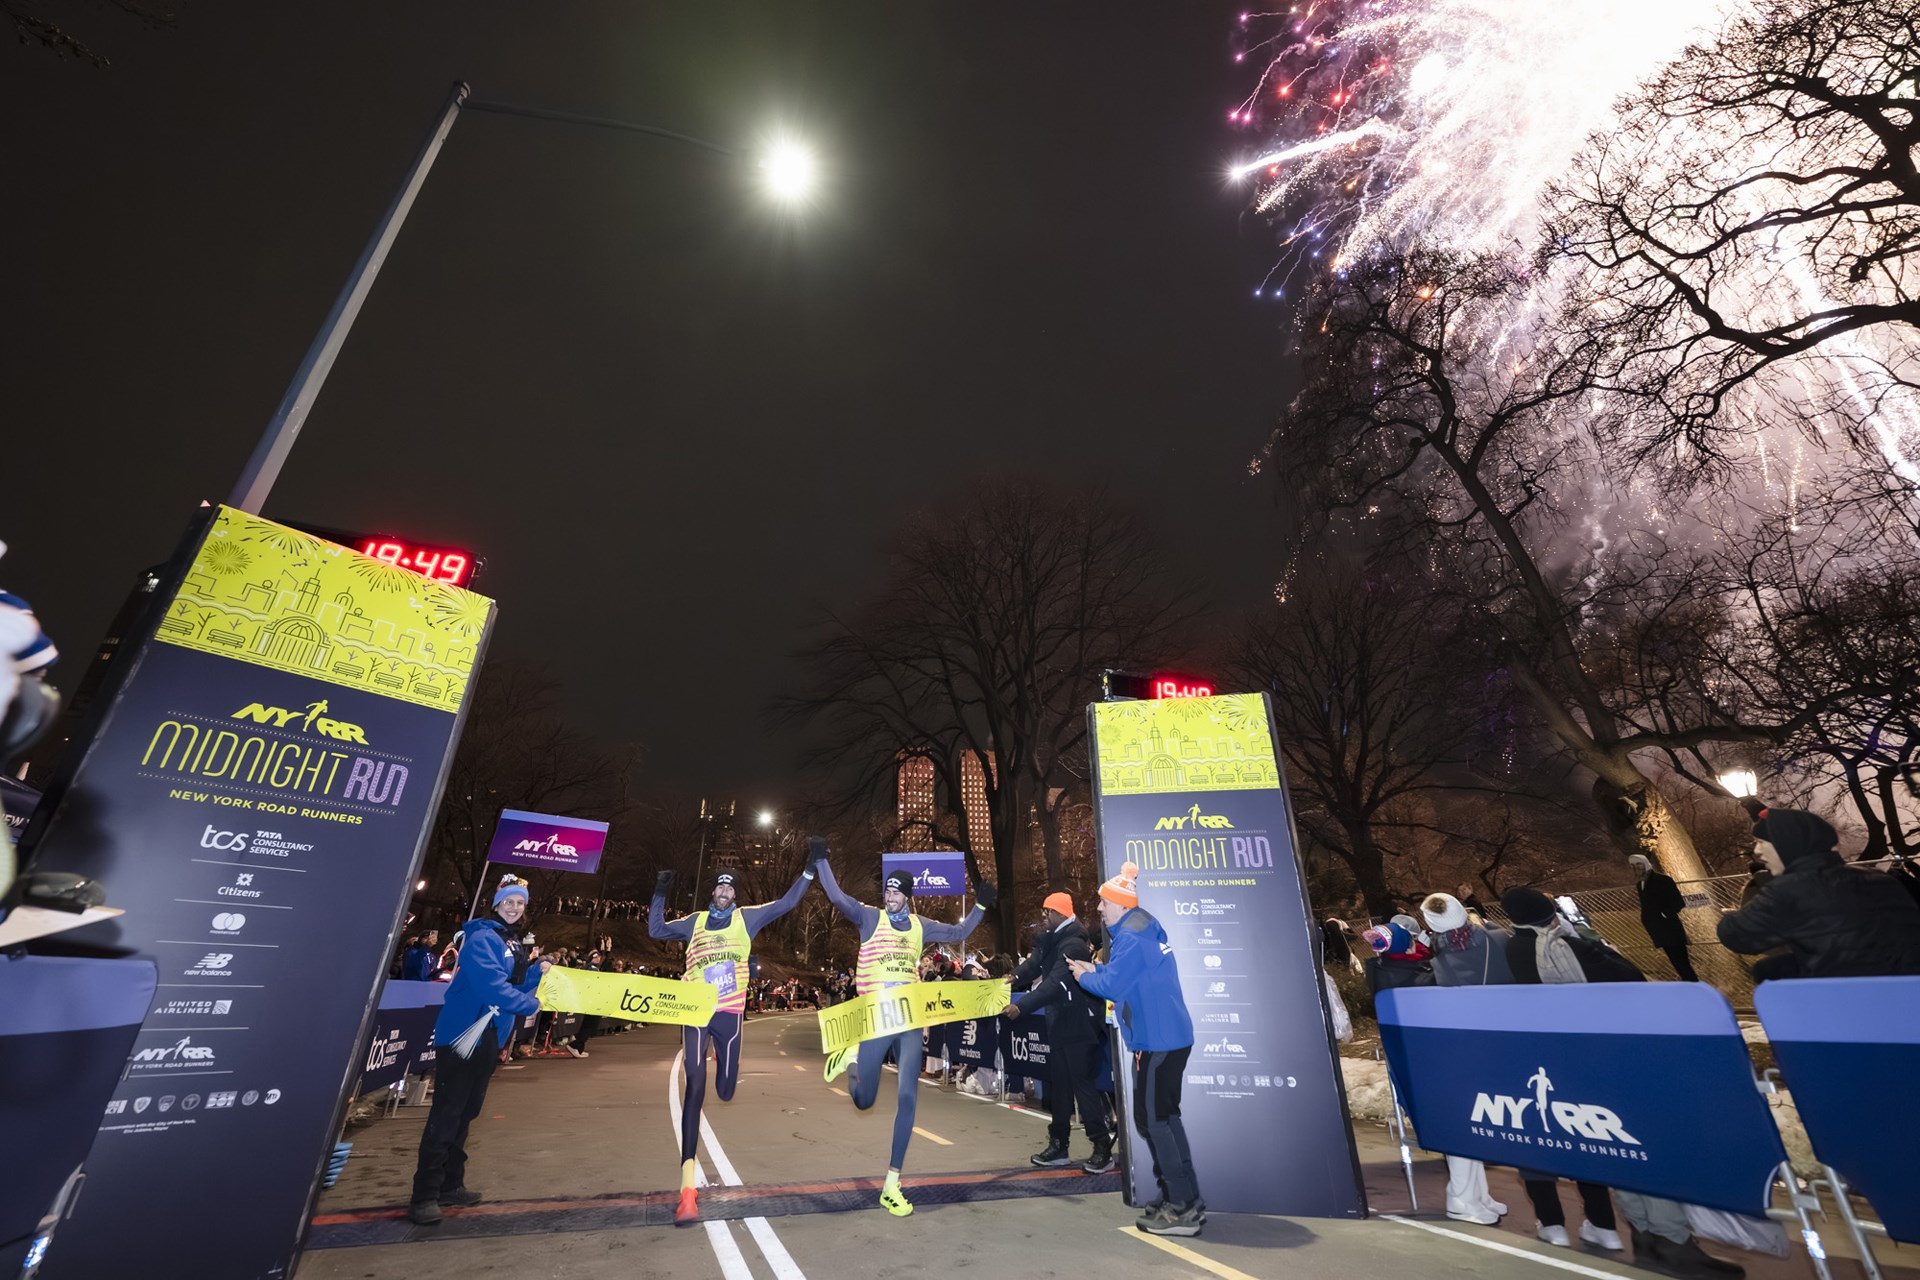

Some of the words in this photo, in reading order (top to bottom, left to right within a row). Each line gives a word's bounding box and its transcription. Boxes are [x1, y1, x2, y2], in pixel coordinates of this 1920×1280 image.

[231, 701, 370, 745] NYRR
[141, 720, 349, 795] MIDNIGHT
[343, 756, 409, 806] RUN
[169, 789, 209, 802] NEW
[213, 795, 254, 809] YORK
[257, 802, 298, 815] ROAD
[300, 808, 363, 825] RUNNERS
[1154, 815, 1235, 830] NYRR
[200, 824, 249, 852] tcs
[256, 830, 282, 840] TATA
[249, 846, 290, 857] SERVICES
[252, 838, 314, 852] CONSULTANCY
[514, 839, 579, 857] NYRR
[1126, 838, 1227, 870] MIDNIGHT
[1232, 836, 1273, 868] RUN
[913, 876, 950, 886] YRR
[217, 886, 261, 898] Citizens
[1174, 899, 1199, 915] tcs
[620, 988, 653, 1013] tcs
[655, 1001, 699, 1012] CONSULTANCY
[925, 999, 954, 1012] NYRR
[652, 1009, 680, 1017] SERVICES
[825, 1004, 875, 1047] MIDNIGHT
[880, 997, 913, 1029] RUN
[133, 1047, 215, 1061] NYRR
[366, 1036, 388, 1072] tcs
[1012, 1030, 1028, 1061] tcs
[1029, 1042, 1051, 1053] CONSULTAN
[1471, 1092, 1642, 1146] NYRR
[1471, 1126, 1494, 1138] NEW
[1500, 1132, 1531, 1144] YORK
[1537, 1137, 1573, 1150] ROAD
[1579, 1143, 1648, 1161] RUNNERS
